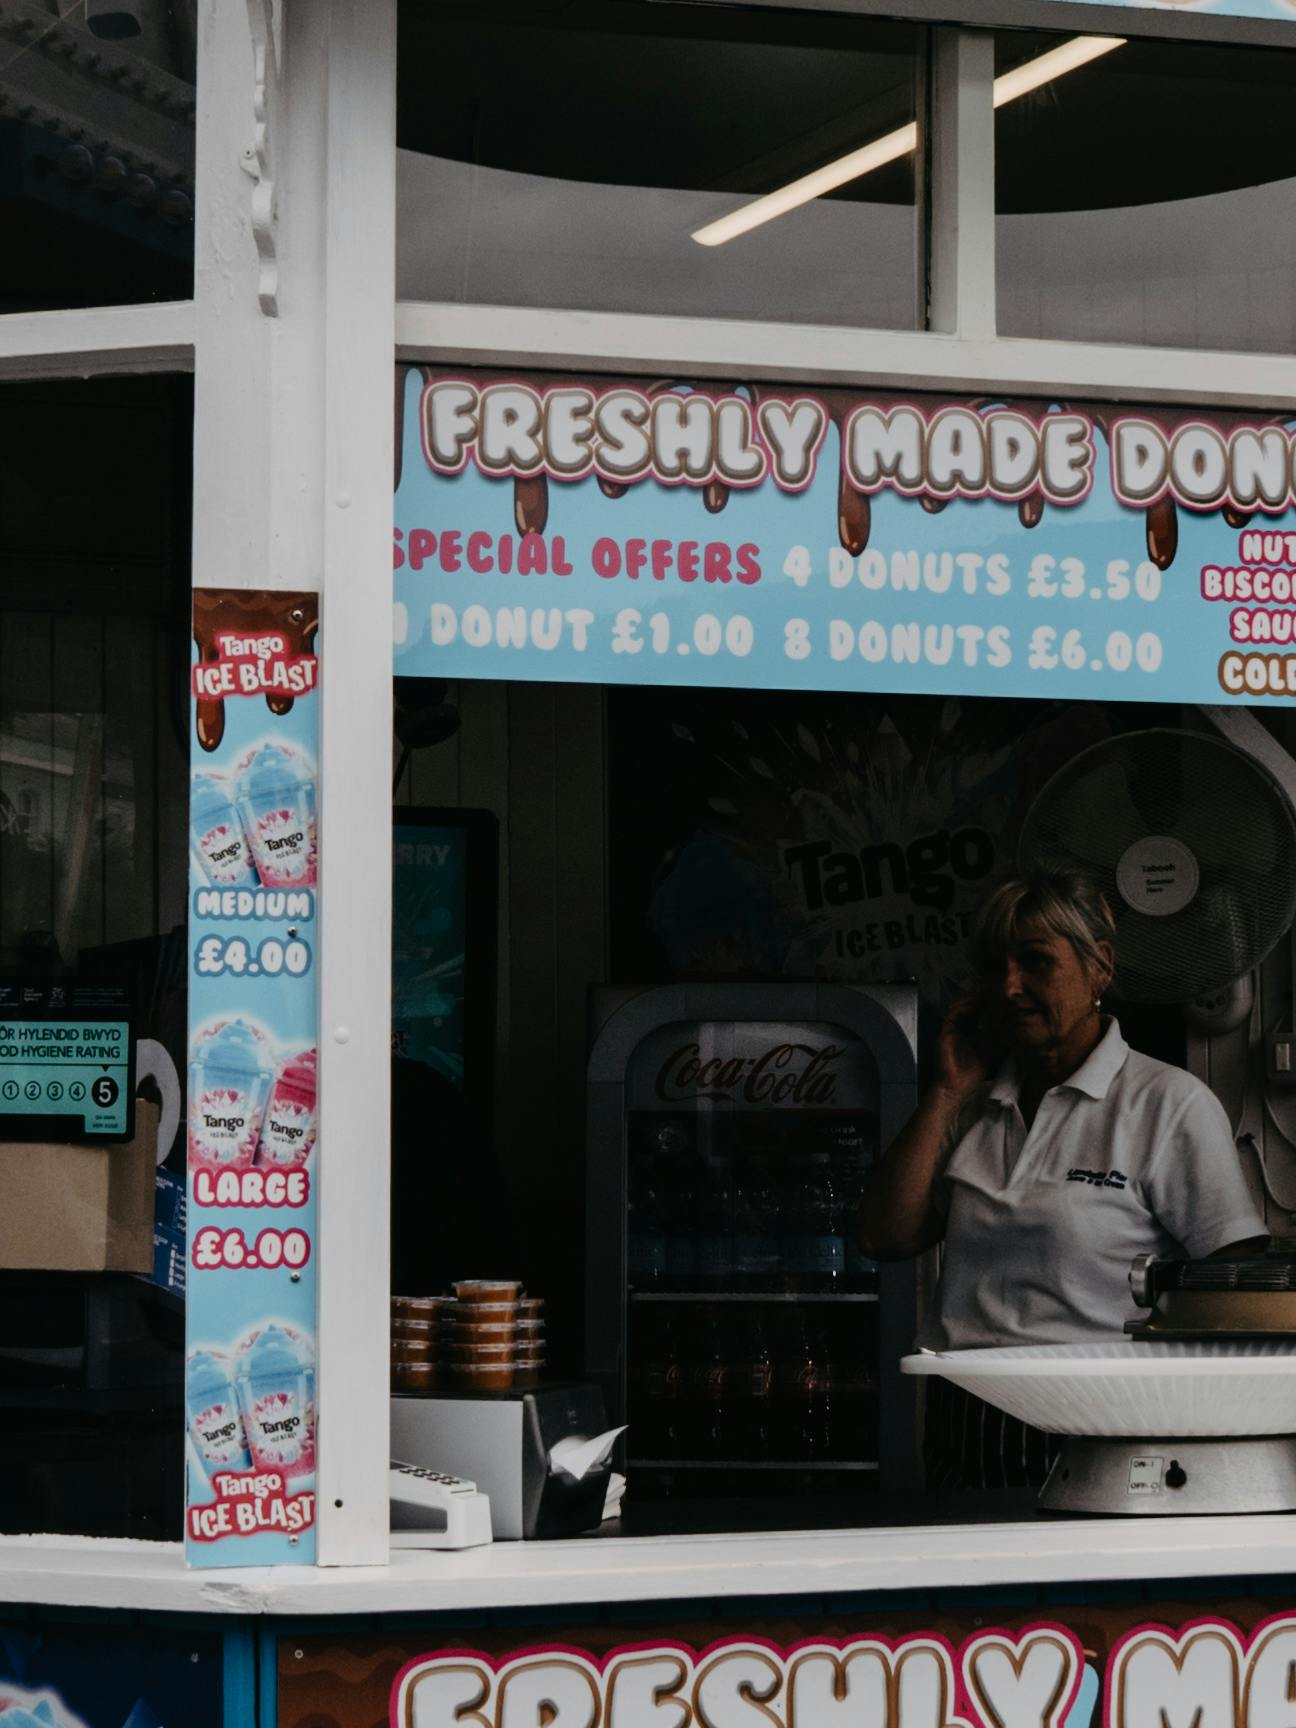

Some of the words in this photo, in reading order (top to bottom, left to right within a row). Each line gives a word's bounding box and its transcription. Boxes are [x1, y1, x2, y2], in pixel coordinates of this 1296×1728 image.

[421, 376, 827, 493] FRESHLY
[839, 400, 1097, 505] MADE
[591, 537, 762, 587] OFFERS
[782, 546, 811, 587] 4
[829, 547, 1010, 596] DONUTS
[1029, 553, 1162, 603] £3.50
[218, 634, 285, 661] Tango
[430, 603, 595, 652] DONUT
[612, 611, 754, 657] £1.00
[783, 619, 811, 659] 8
[829, 620, 1010, 667] DONUTS
[1028, 627, 1163, 673] £6.00
[196, 664, 235, 696] ICE
[239, 657, 316, 692] BLAST
[208, 842, 241, 862] Tango
[265, 832, 303, 851] Tango
[785, 828, 995, 912] Tango
[195, 888, 312, 921] MEDIUM
[836, 924, 880, 958] ICE
[884, 913, 971, 950] BLAST
[196, 937, 310, 977] £4.00
[19, 1029, 79, 1040] HYLENDID
[83, 1029, 121, 1041] BWYD
[21, 1046, 72, 1057] HYGIENE
[76, 1047, 120, 1058] RATING
[656, 1043, 847, 1104] Coca-Cola
[97, 1081, 113, 1104] 5
[203, 1114, 244, 1131] Tango
[269, 1120, 303, 1139] Tango
[193, 1170, 308, 1207] LARGE
[192, 1227, 309, 1270] £6.00
[202, 1423, 236, 1441] Tango
[260, 1417, 299, 1434] Tango
[215, 1474, 282, 1503] Tango
[191, 1505, 232, 1537] ICE
[235, 1494, 314, 1533] BLAST
